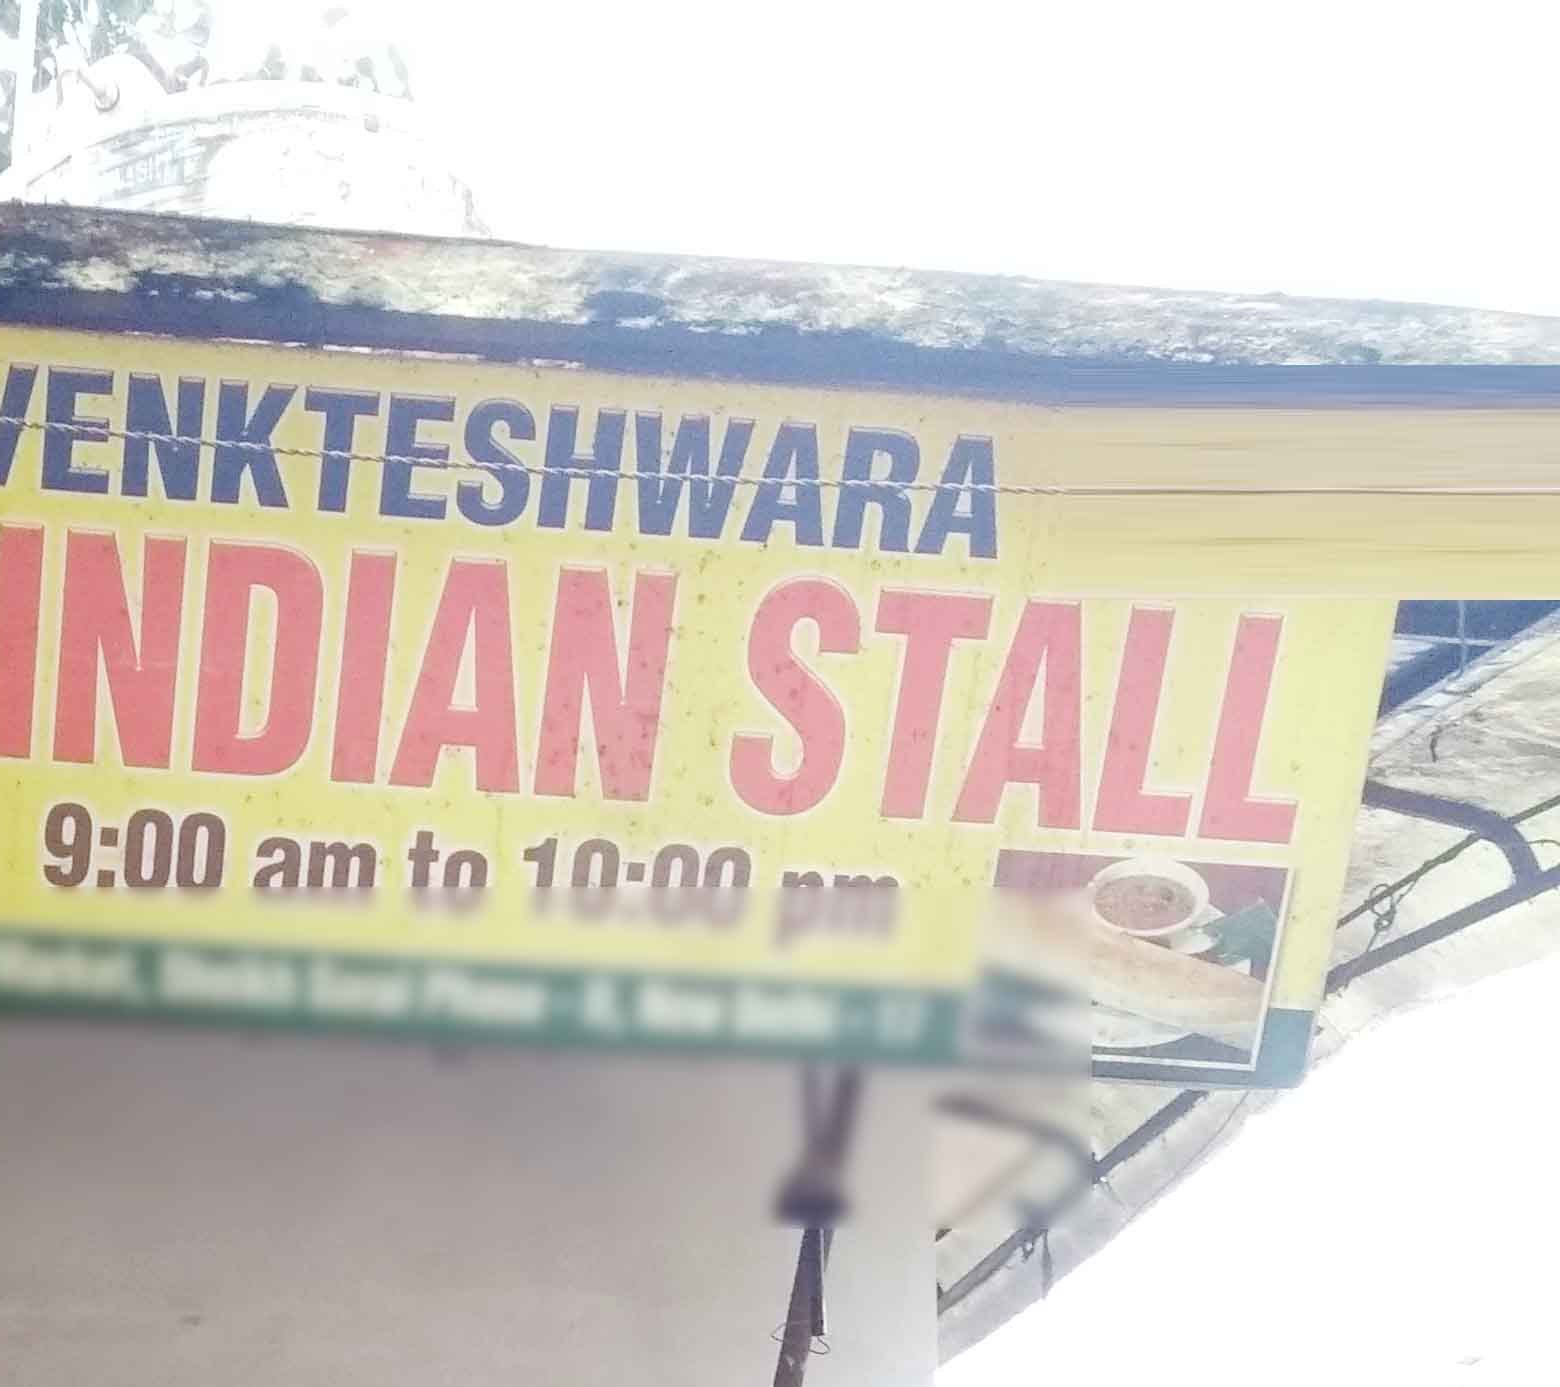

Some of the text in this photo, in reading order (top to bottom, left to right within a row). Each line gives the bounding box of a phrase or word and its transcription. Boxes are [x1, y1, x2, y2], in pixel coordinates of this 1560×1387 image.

[729, 575, 1298, 845] STALL
[42, 800, 228, 890] 9:00
[253, 833, 377, 900] am
[407, 831, 488, 914] to
[523, 835, 752, 927] 10:00
